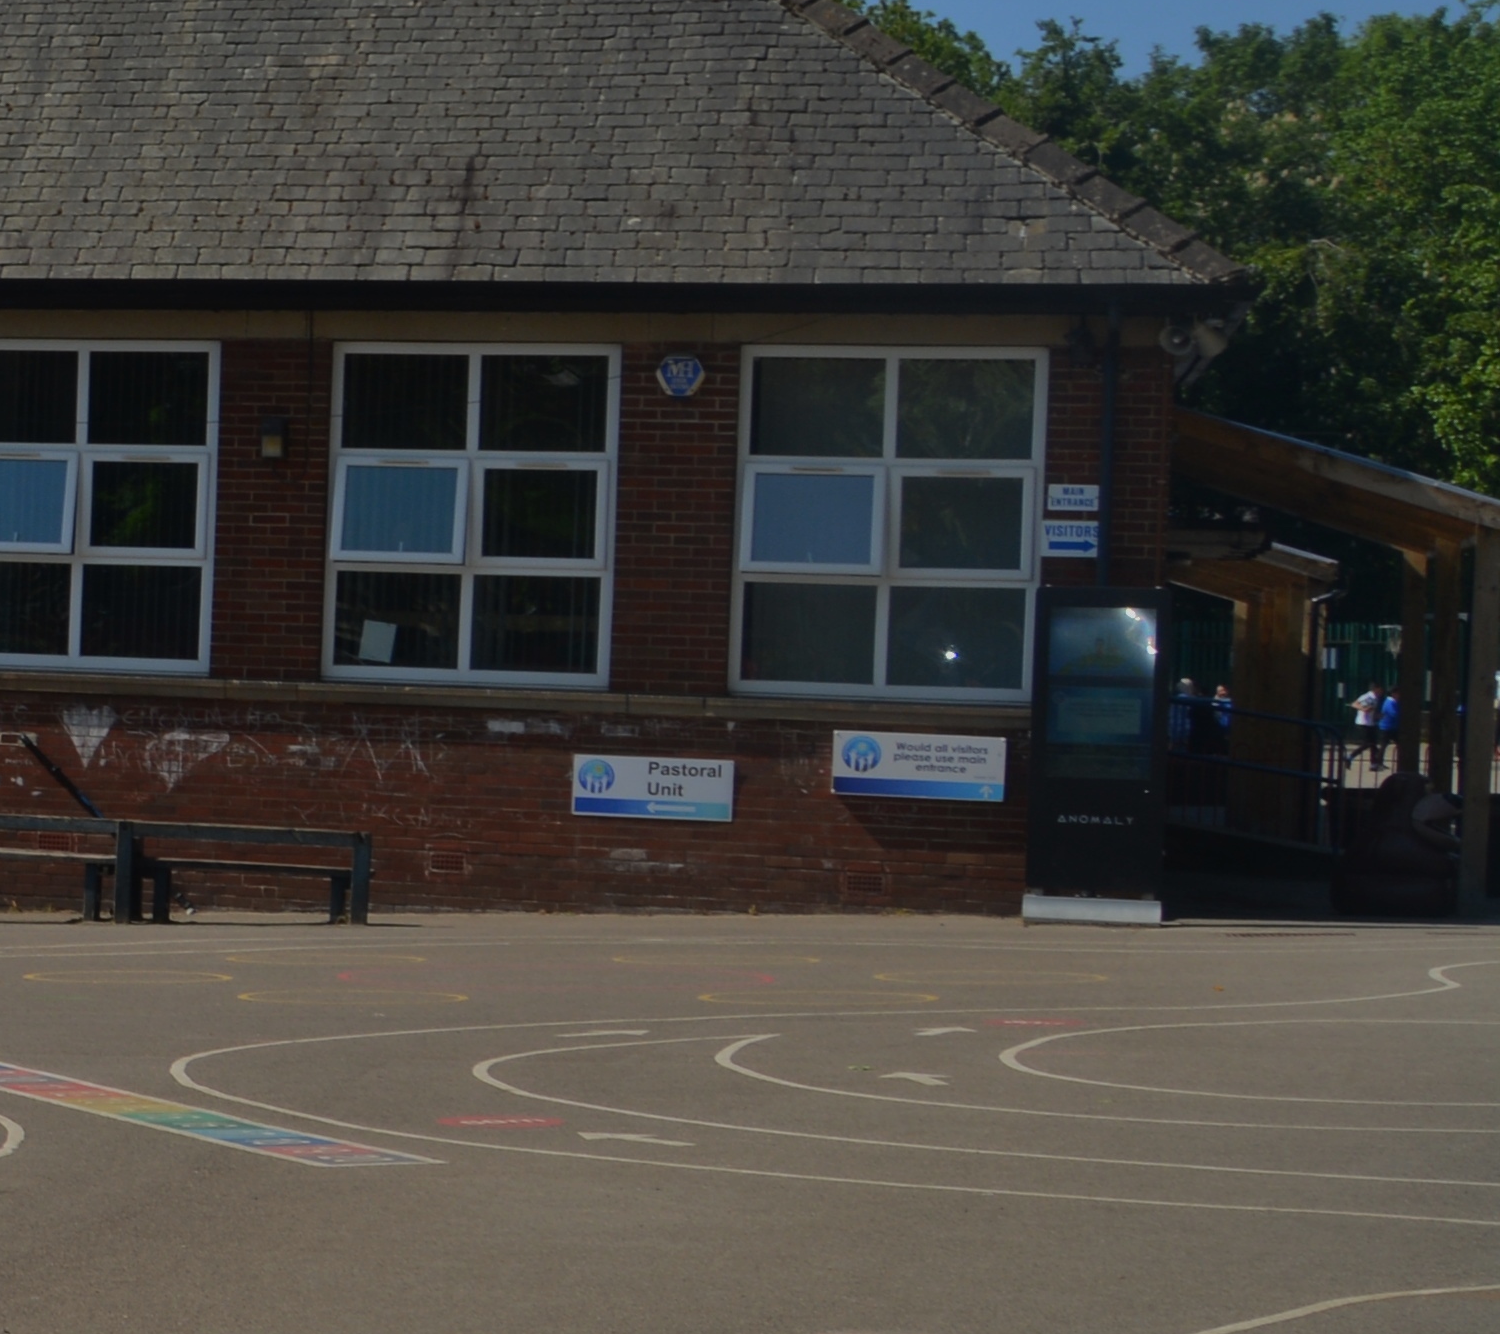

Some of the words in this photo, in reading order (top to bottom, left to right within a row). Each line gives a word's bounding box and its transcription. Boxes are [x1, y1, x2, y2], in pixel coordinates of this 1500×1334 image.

[1063, 487, 1084, 496] MAIN
[1051, 498, 1095, 507] ENTRANCE
[1045, 525, 1100, 538] VISITORS
[896, 742, 932, 752] Would
[934, 744, 948, 753] all
[951, 744, 988, 755] visitors
[893, 752, 933, 762] please
[935, 755, 954, 763] use
[958, 754, 987, 764] main
[648, 761, 722, 778] Pastoral
[915, 764, 967, 774] entrance
[647, 782, 684, 797] Unit
[1057, 814, 1134, 826] ANOMALY
